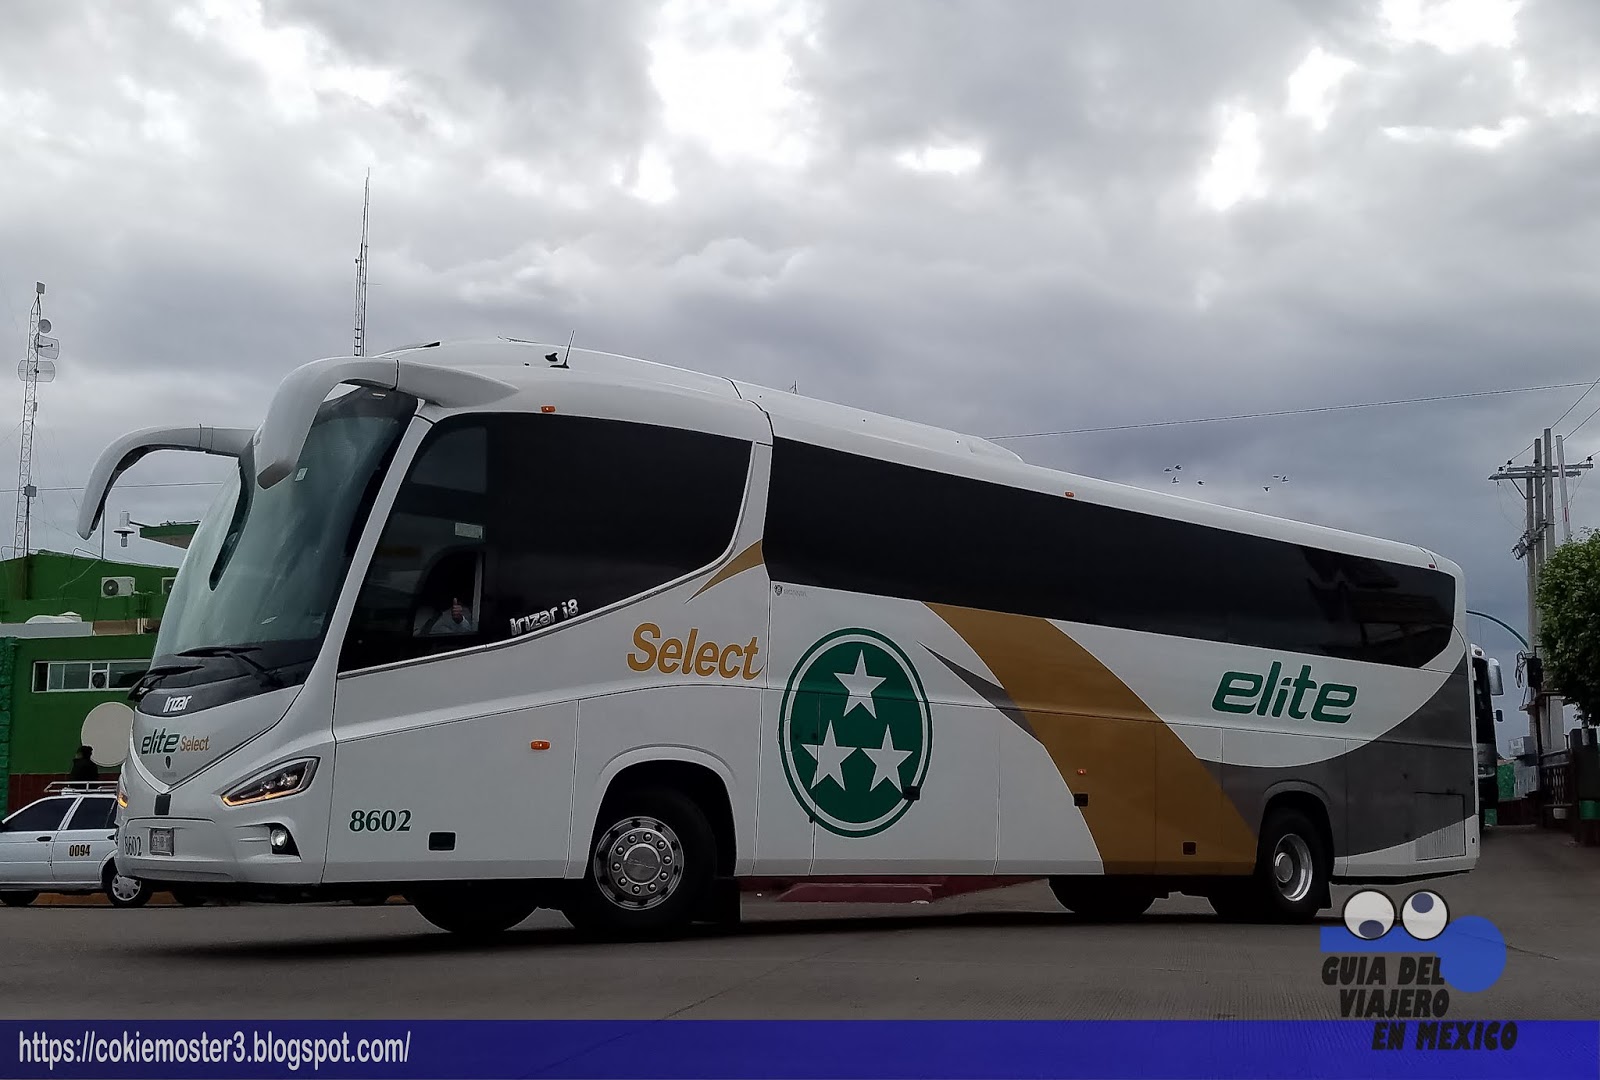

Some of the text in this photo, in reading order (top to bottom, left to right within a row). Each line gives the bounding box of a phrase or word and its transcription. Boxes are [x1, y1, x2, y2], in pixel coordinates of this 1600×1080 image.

[561, 598, 579, 619] i8
[626, 621, 766, 681] Select
[1211, 660, 1358, 724] elite
[140, 727, 210, 755] elite Select
[348, 808, 413, 832] 8602
[68, 844, 91, 857] 0094
[124, 835, 143, 857] 8602
